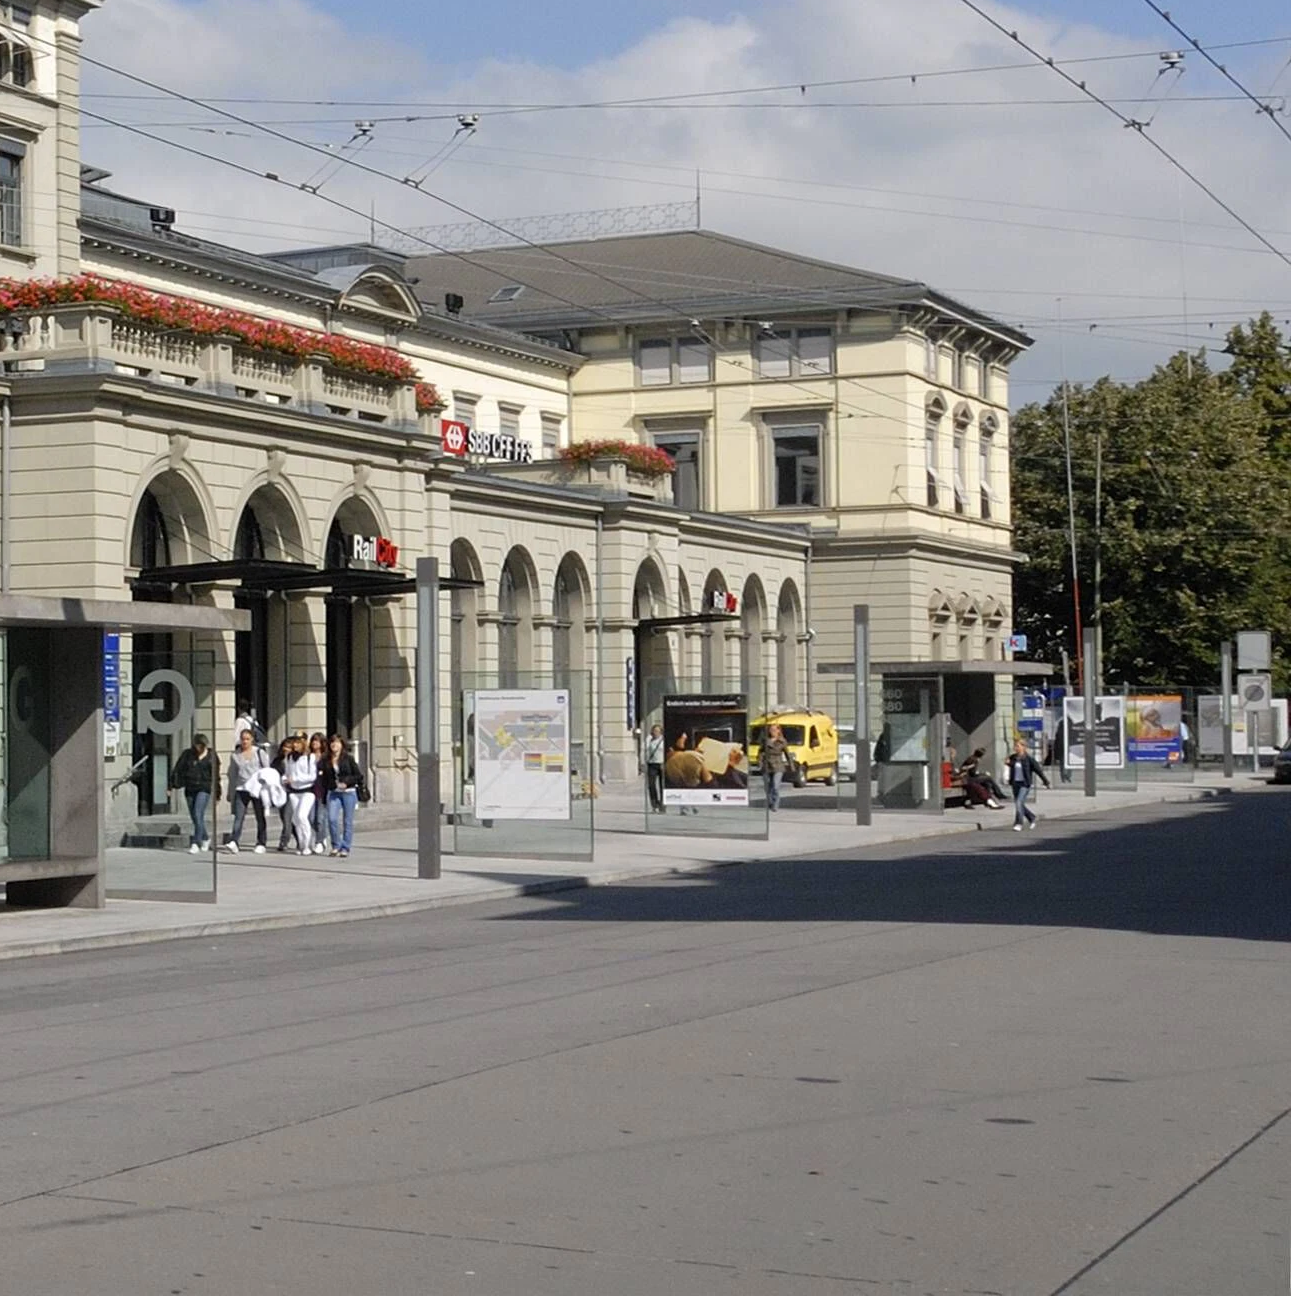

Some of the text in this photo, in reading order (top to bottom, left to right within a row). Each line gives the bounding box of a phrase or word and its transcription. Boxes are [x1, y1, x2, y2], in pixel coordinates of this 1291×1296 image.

[468, 428, 534, 464] SBB CFF FFS
[353, 533, 399, 568] RailCity
